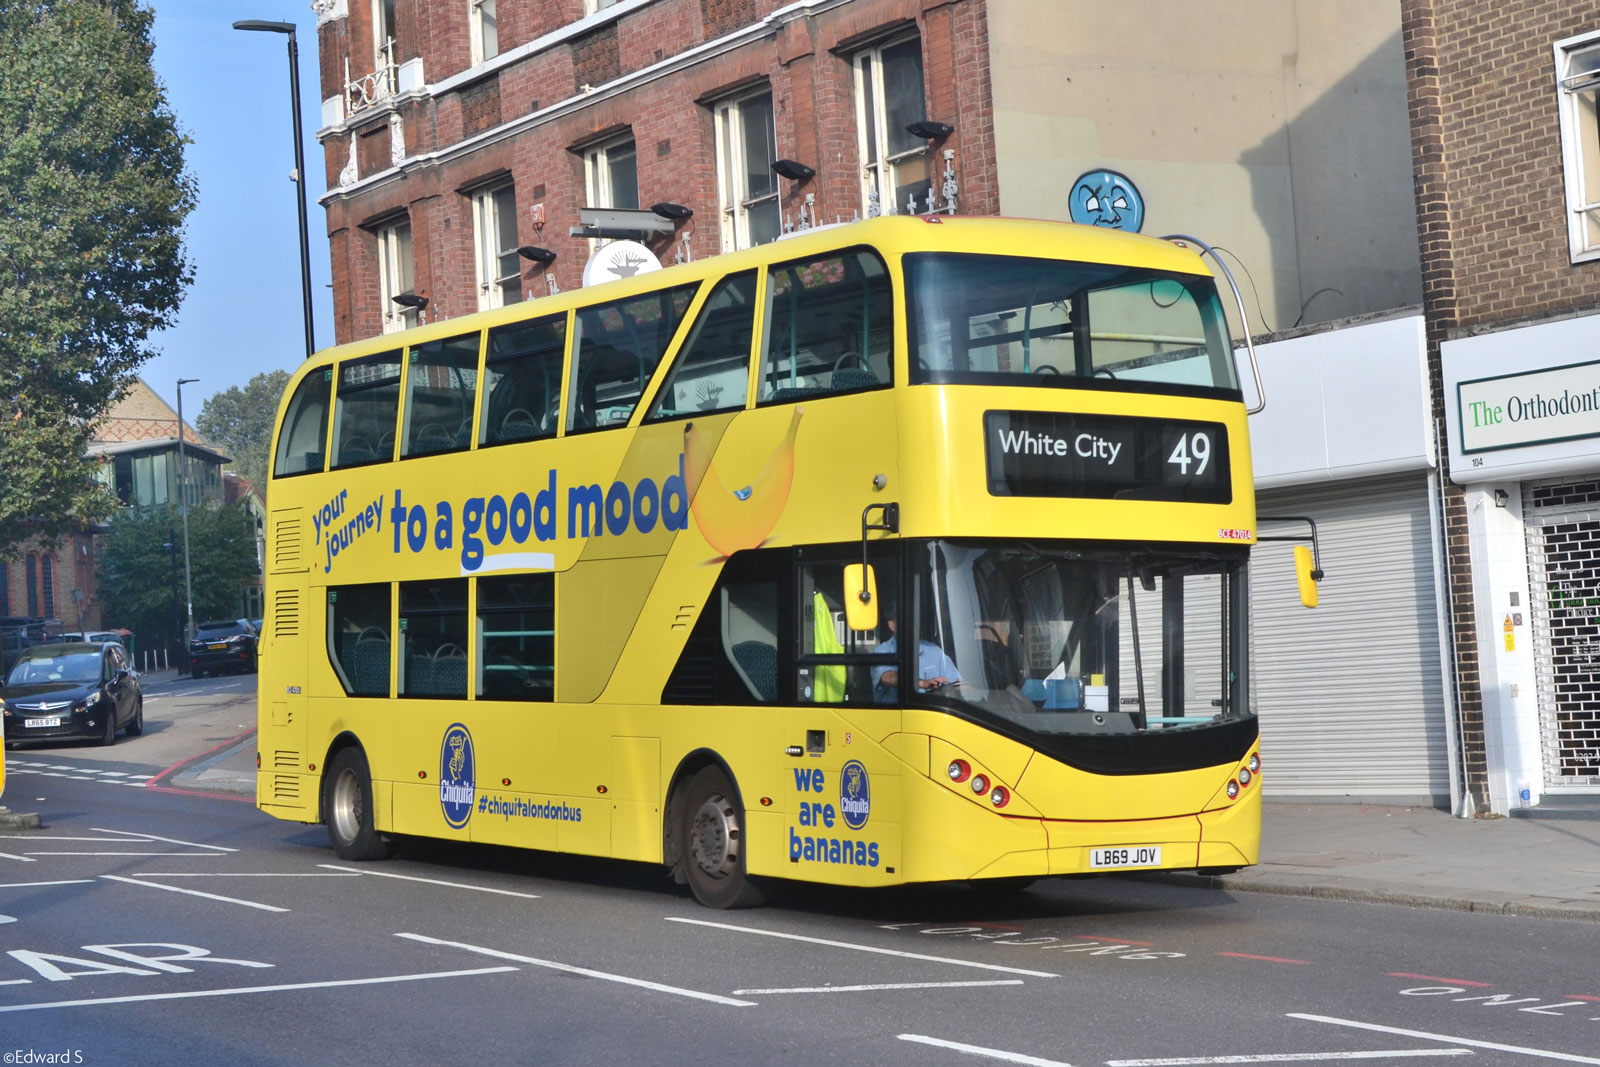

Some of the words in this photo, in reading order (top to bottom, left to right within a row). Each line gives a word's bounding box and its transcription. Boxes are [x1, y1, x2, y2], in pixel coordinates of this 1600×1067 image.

[1469, 401, 1503, 427] The
[1507, 386, 1600, 422] Orthodont
[998, 429, 1068, 455] White
[1075, 433, 1122, 465] City
[1168, 432, 1211, 475] 49
[1472, 458, 1483, 467] 104
[312, 488, 348, 546] your
[391, 489, 427, 553] to
[434, 501, 453, 550] a
[461, 469, 557, 571] good
[567, 453, 689, 539] mood
[324, 494, 384, 574] journey
[441, 779, 474, 811] Chiquita
[793, 768, 825, 793] we
[478, 795, 582, 822] #chiquitalondonbus
[799, 802, 836, 828] are
[841, 797, 869, 818] Chiquita
[789, 826, 880, 867] bananas
[1095, 850, 1128, 865] LB69
[1132, 848, 1156, 864] JOV
[1399, 986, 1600, 1021] ONL
